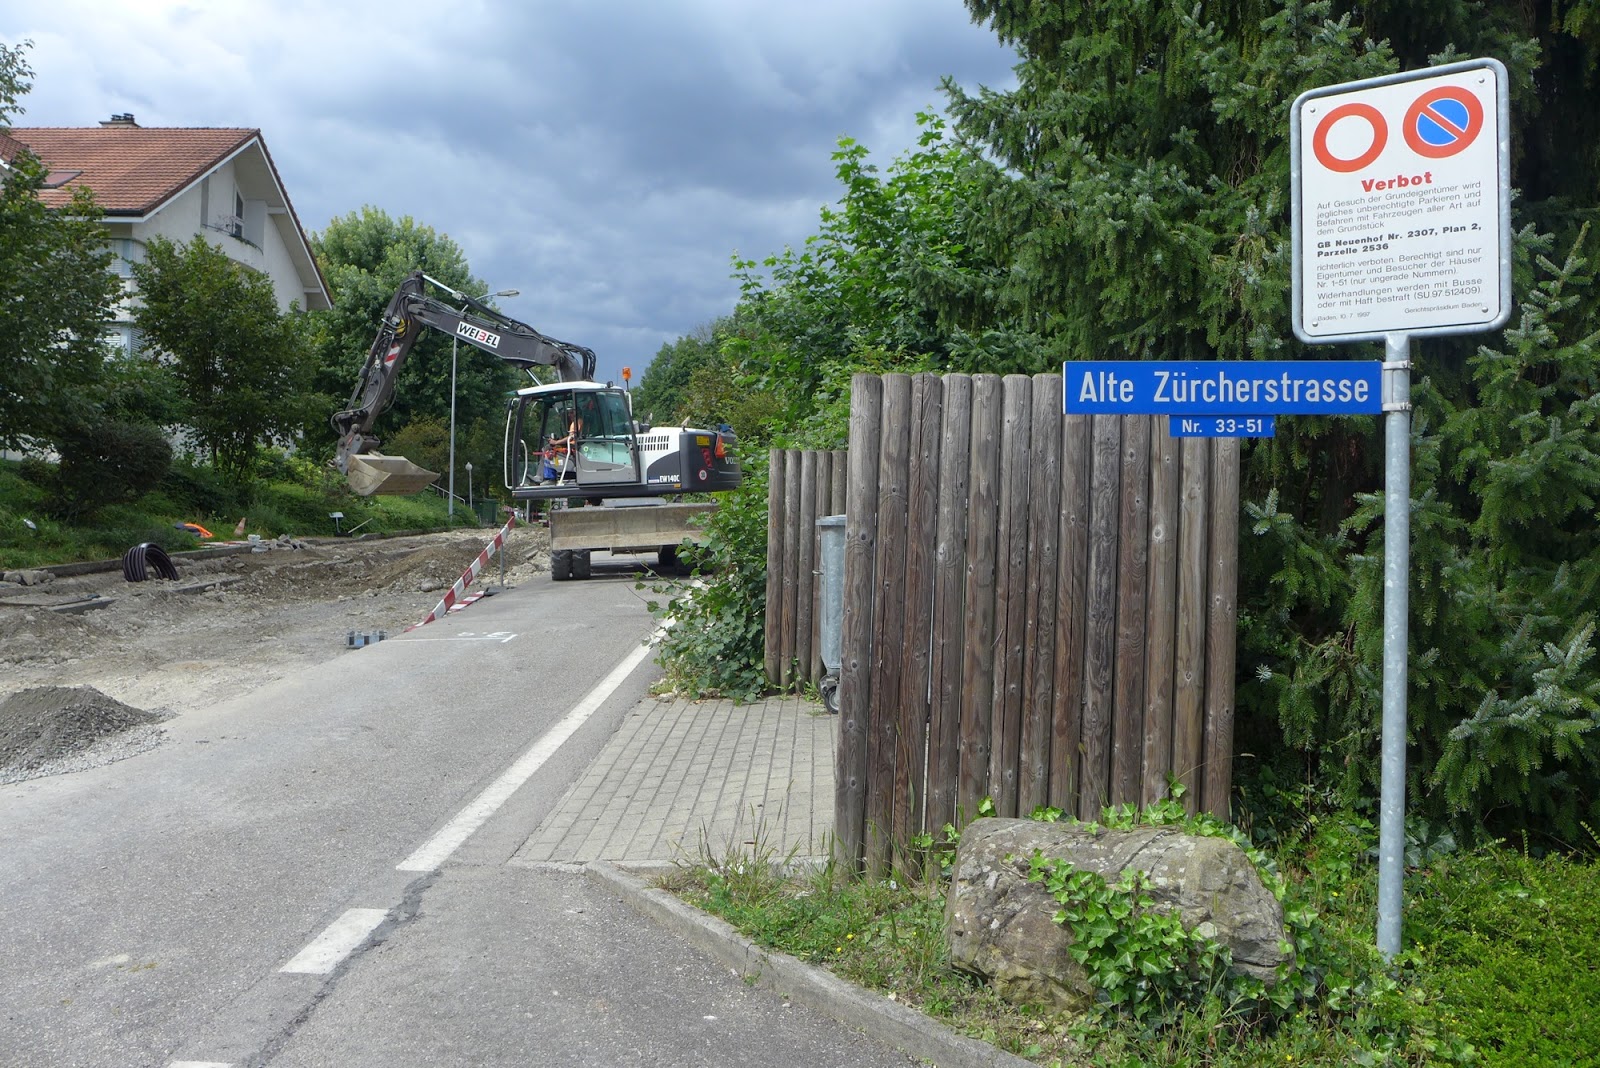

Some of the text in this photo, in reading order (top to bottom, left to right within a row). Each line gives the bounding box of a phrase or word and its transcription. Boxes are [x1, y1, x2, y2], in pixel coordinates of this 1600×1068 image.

[1361, 172, 1432, 192] Verbot
[1334, 198, 1365, 208] Gesuch
[1462, 180, 1480, 190] wird
[1317, 190, 1480, 219] jegliches unberechtigte Parkieren und
[1317, 217, 1353, 227] Befahren
[1373, 208, 1422, 219] Fahrzeugen
[1466, 199, 1480, 207] auf
[1338, 221, 1384, 233] Grundstück
[1336, 235, 1383, 246] Neuenhof
[1408, 228, 1438, 238] 2307,
[1317, 243, 1388, 257] Parzelle 2536
[1317, 261, 1354, 271] richterlich
[1399, 252, 1441, 262] Berechtigt
[1446, 248, 1464, 257] sind
[1386, 262, 1427, 272] Besucher
[1370, 273, 1408, 283] ungerade
[1318, 287, 1392, 300] Widerhandlungen
[1397, 284, 1430, 292] werden
[1452, 278, 1482, 286] Busse
[1377, 294, 1410, 303] bestraft
[1079, 371, 1369, 402] Alte Zürcherstrasse
[1182, 419, 1262, 433] Nr. 33-51
